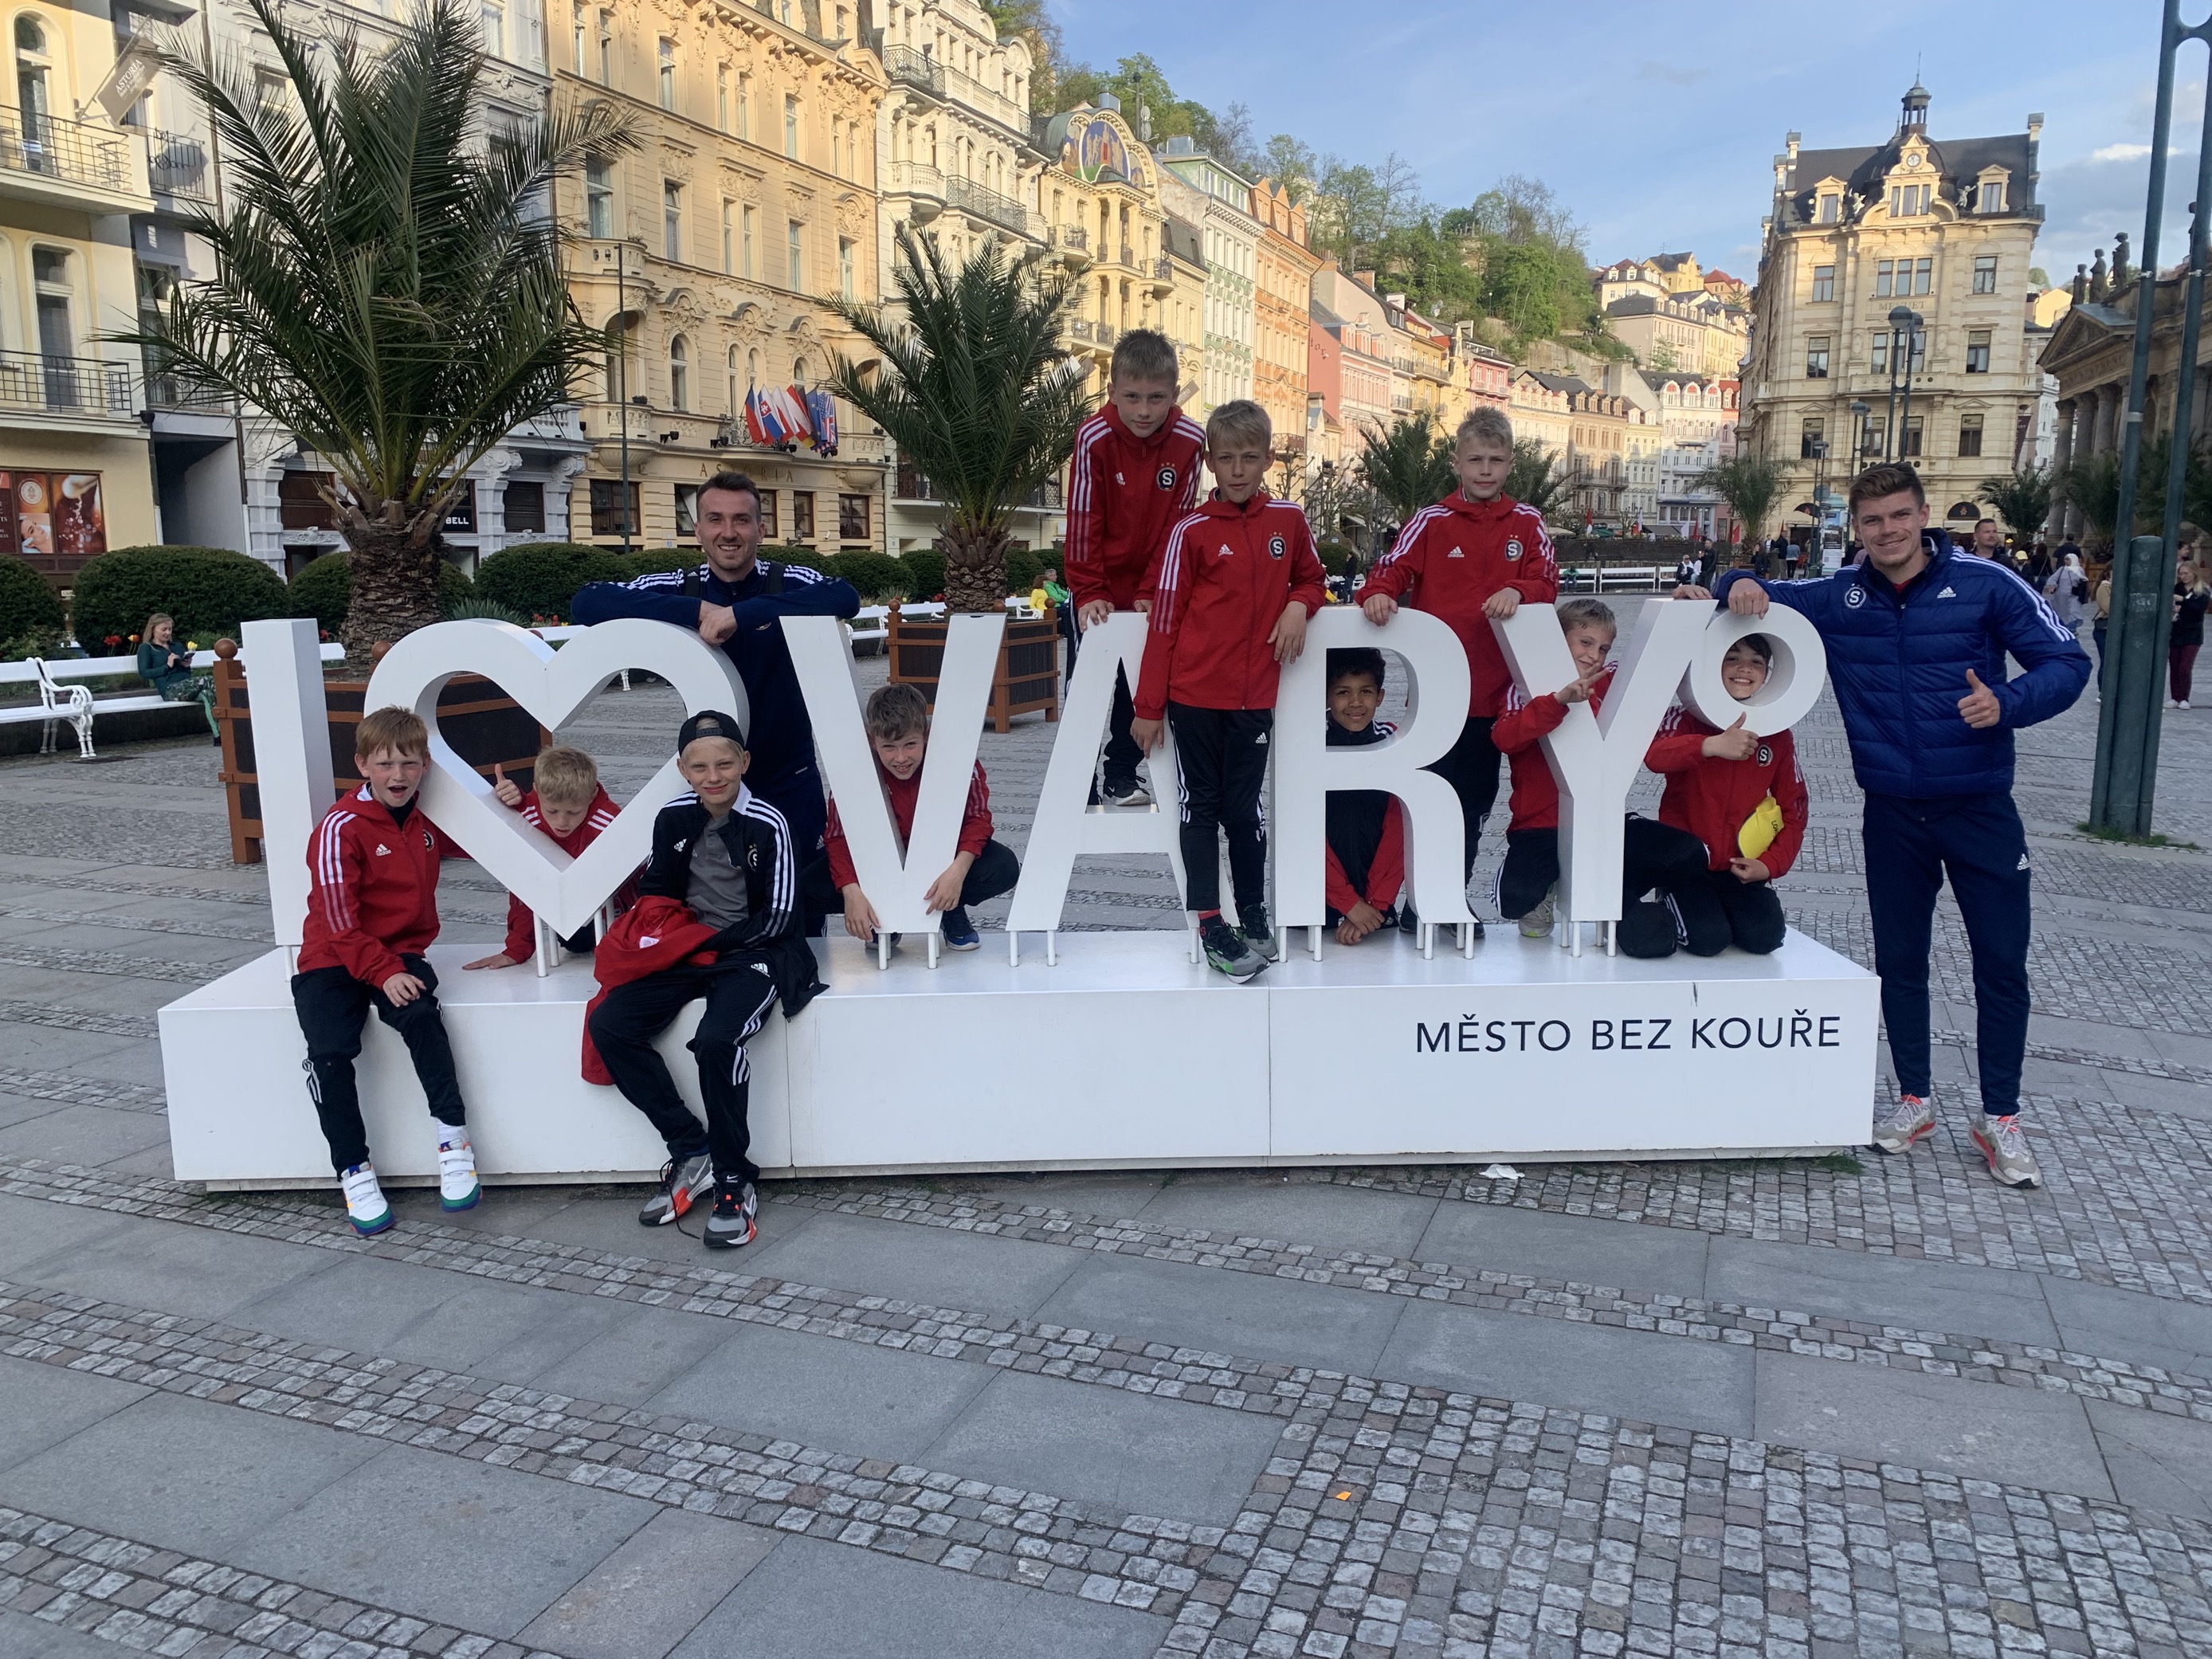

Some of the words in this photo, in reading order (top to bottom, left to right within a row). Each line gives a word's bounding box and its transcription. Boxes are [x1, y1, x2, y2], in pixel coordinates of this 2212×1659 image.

[115, 59, 143, 94] ASTORIA
[1417, 1014, 1571, 1053] MĚSTO
[1591, 1018, 1672, 1050] BEZ
[1692, 1008, 1841, 1049] KOUŘE
